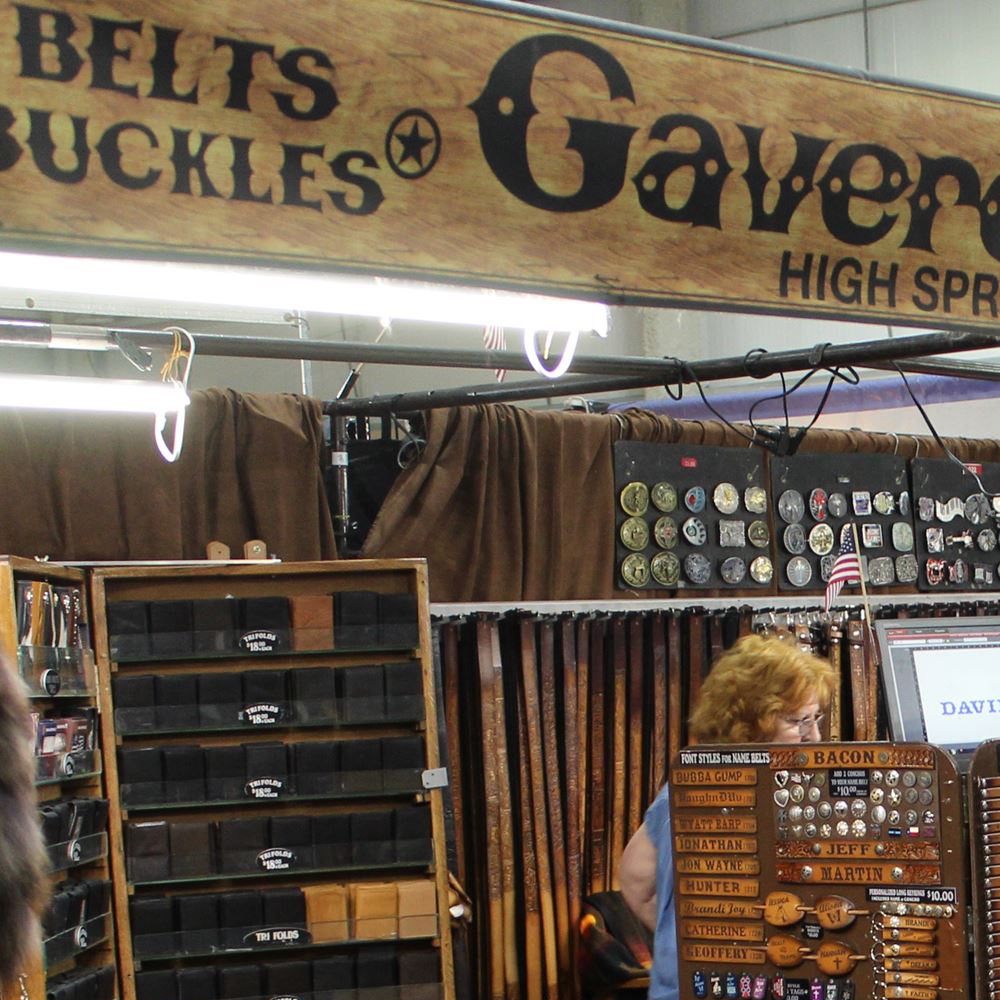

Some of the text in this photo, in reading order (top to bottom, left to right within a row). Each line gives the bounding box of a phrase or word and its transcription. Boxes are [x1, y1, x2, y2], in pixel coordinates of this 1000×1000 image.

[16, 5, 340, 121] BELTS
[779, 251, 899, 309] HIGH
[681, 753, 697, 764] FONT
[699, 753, 720, 764] STYLES
[732, 753, 750, 763] NAME
[751, 752, 770, 763] BELTS
[814, 751, 874, 764] BACON
[675, 771, 711, 783] BUBBA
[715, 771, 742, 782] GUMP
[716, 818, 741, 830] EARP
[679, 839, 742, 850] JONATHAN
[826, 843, 870, 855] JEFF
[704, 859, 743, 871] WAYNE
[821, 867, 883, 881] MARTIN
[686, 880, 740, 892] HUNTER
[927, 890, 954, 901] $10.00
[684, 902, 745, 915] Brandi Joy
[256, 930, 299, 942] TRI FOLDS
[688, 925, 746, 937] CATHERINE
